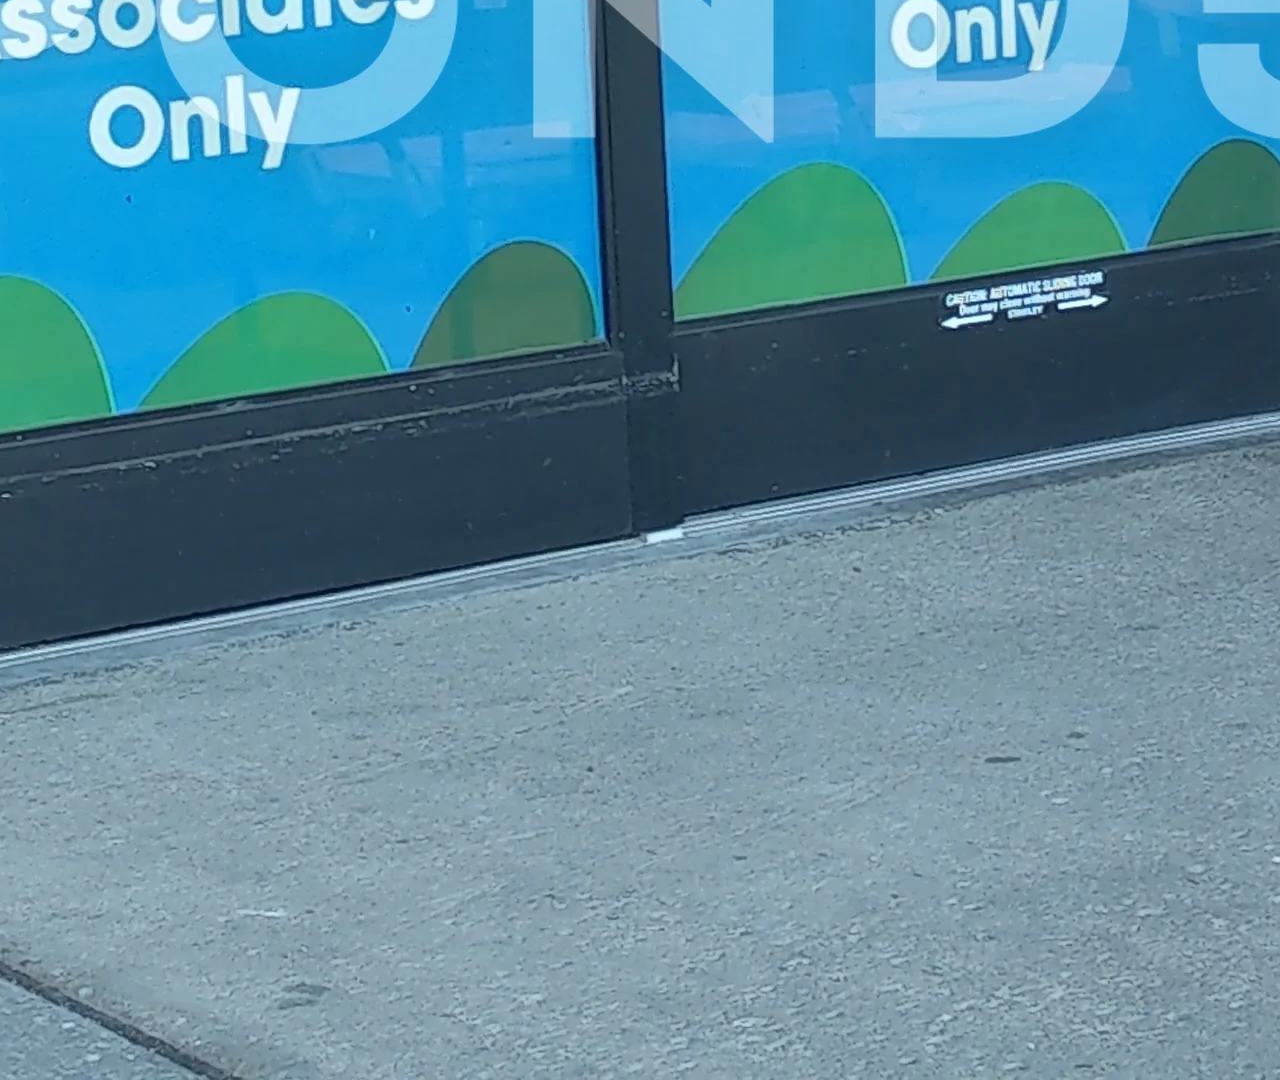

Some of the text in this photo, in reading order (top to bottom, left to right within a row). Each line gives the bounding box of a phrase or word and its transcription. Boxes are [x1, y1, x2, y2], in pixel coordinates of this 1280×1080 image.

[89, 74, 302, 169] Only
[990, 282, 1041, 299] AUTOMATIC
[1042, 276, 1077, 292] SLIDING
[1078, 272, 1104, 286] DOOR
